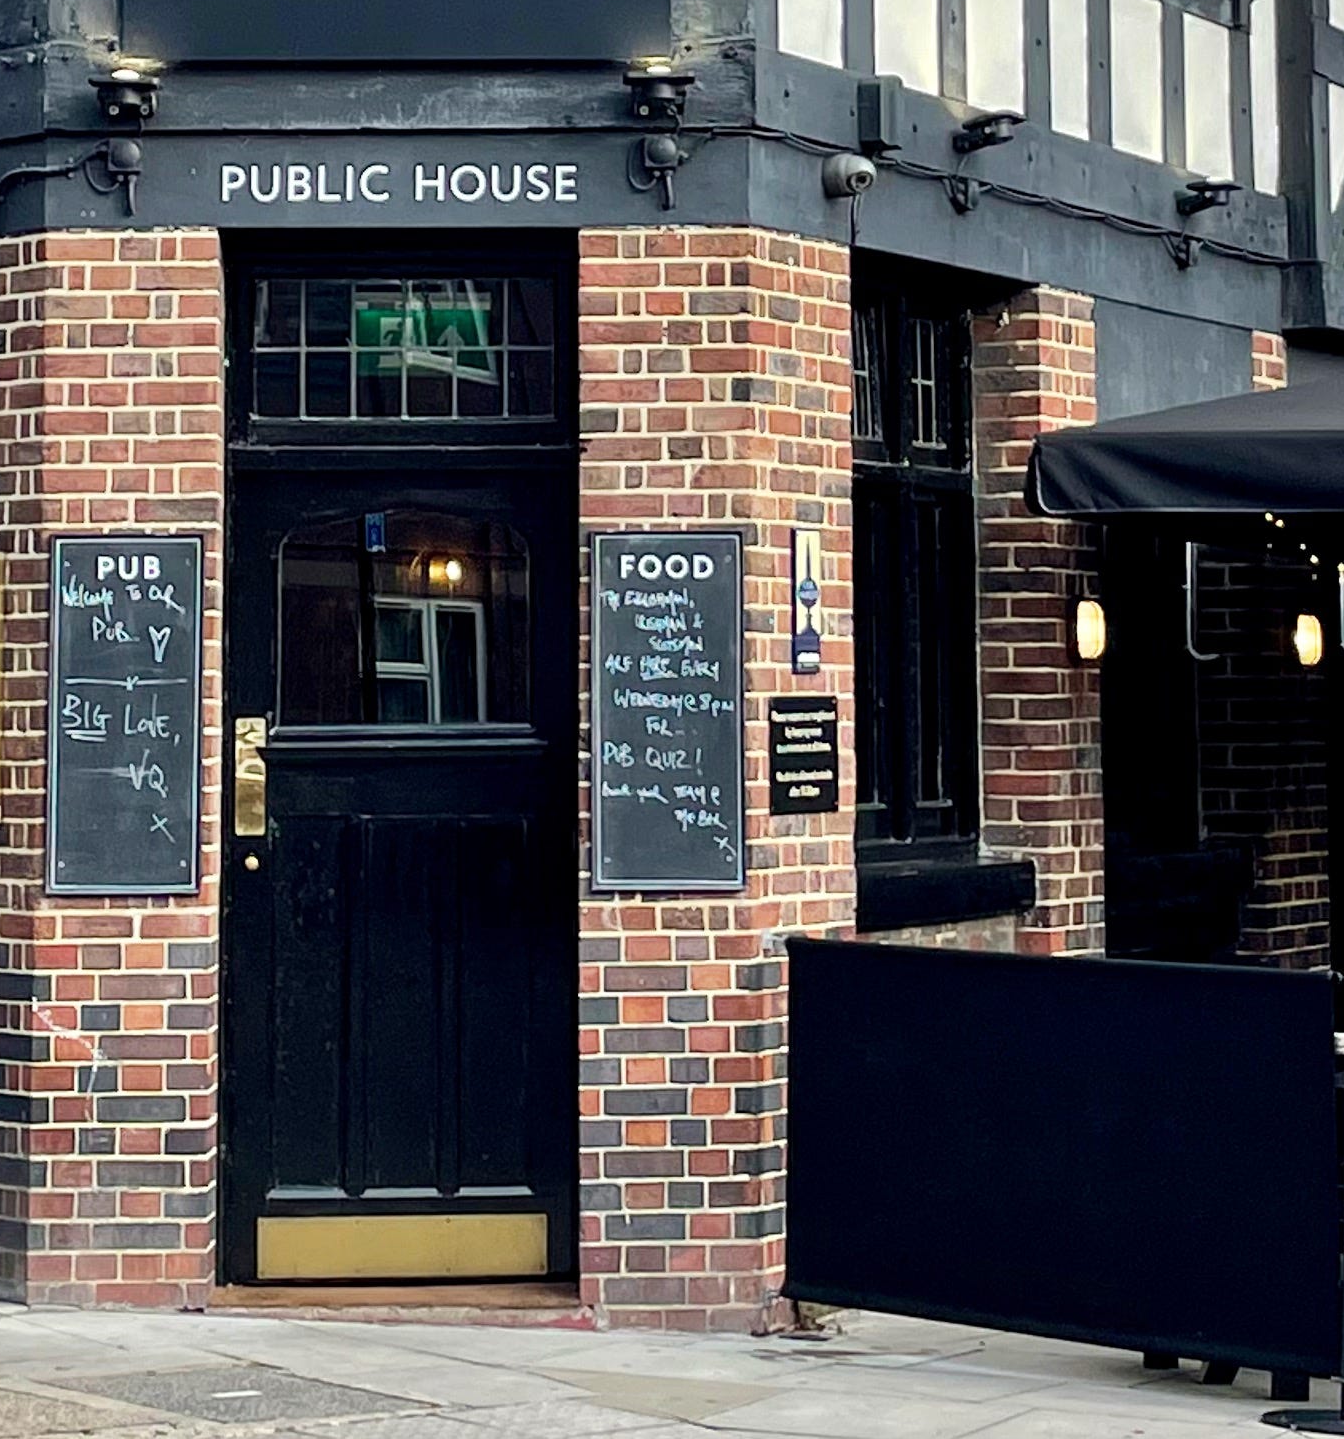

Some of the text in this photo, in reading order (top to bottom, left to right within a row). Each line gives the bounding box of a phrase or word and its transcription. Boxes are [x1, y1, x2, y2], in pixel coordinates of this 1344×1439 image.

[220, 164, 578, 203] PUBLIC HOUSE
[96, 555, 162, 581] PUB
[619, 553, 715, 580] FOOD
[61, 693, 113, 732] BIG
